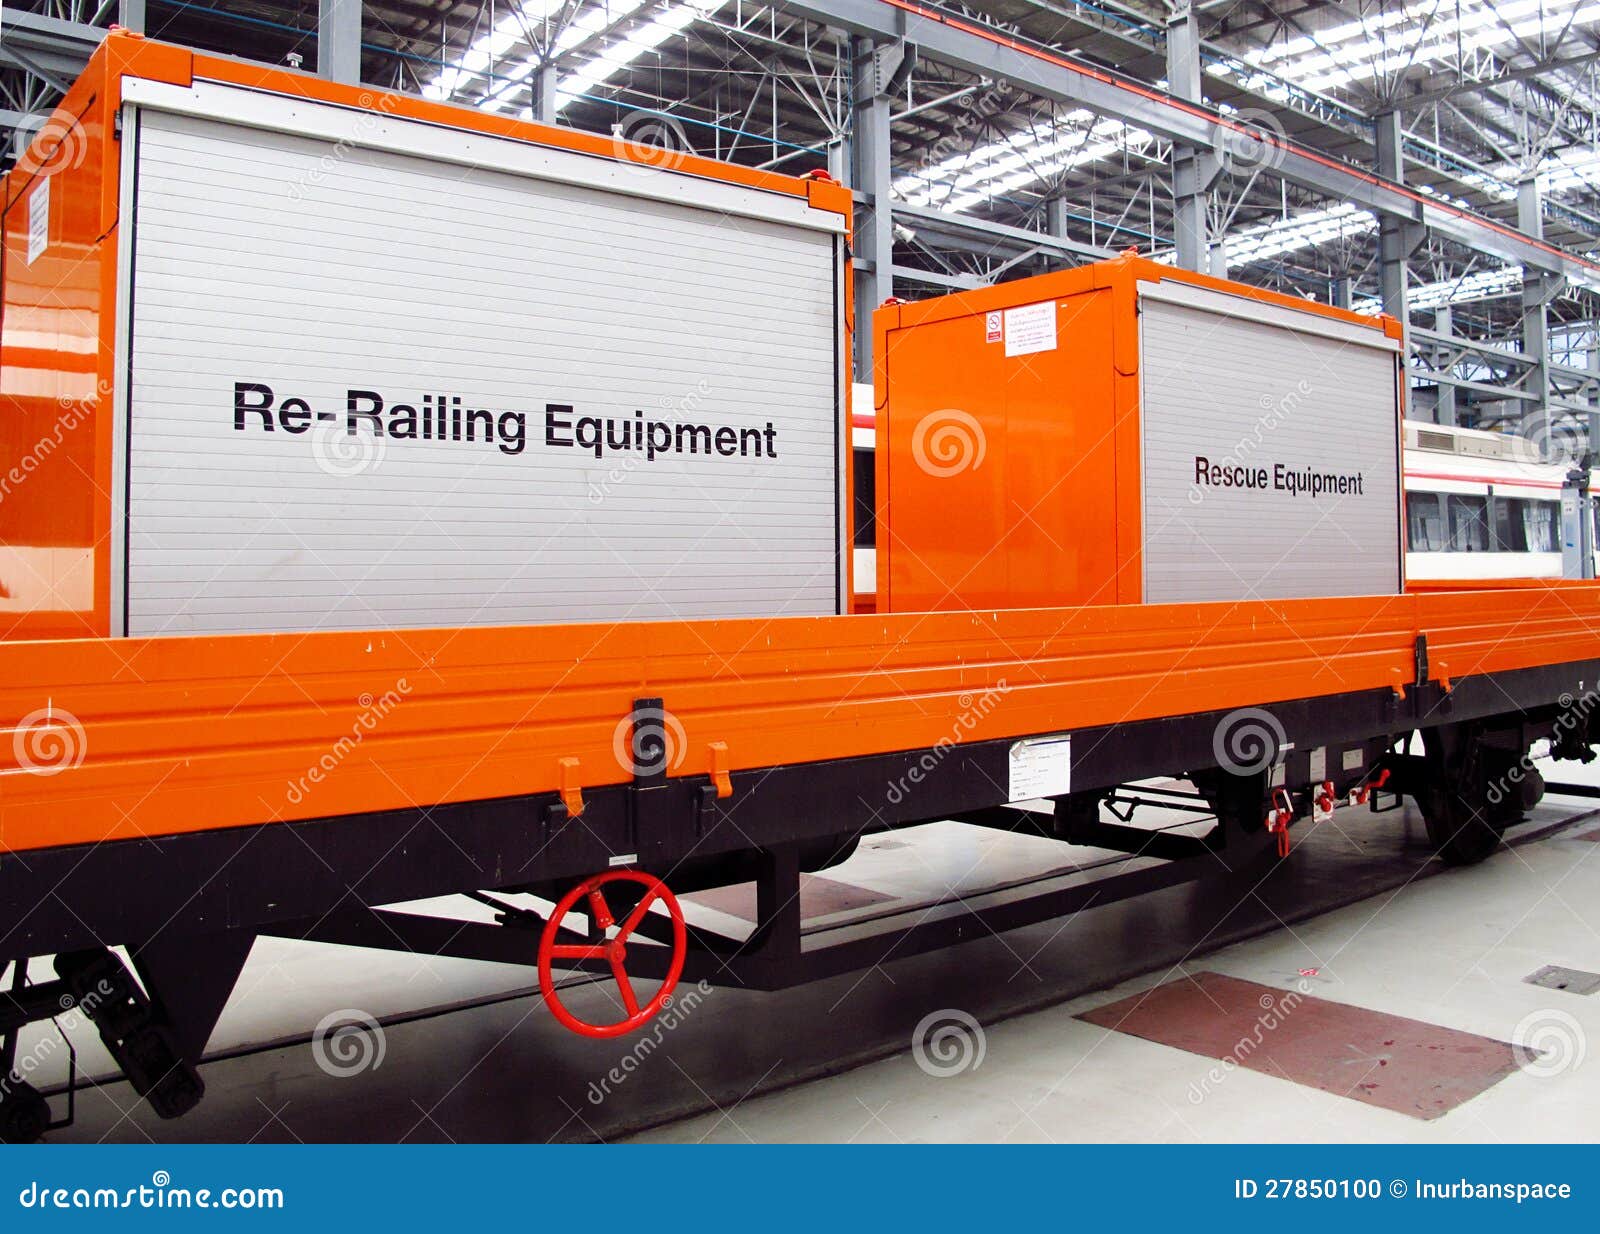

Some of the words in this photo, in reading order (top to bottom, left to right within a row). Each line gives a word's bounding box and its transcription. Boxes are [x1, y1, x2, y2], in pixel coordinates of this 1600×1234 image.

[234, 381, 526, 456] Re-Railing
[545, 403, 778, 462] Equipment
[1195, 456, 1268, 490] Rescue
[1273, 463, 1364, 499] Equipment
